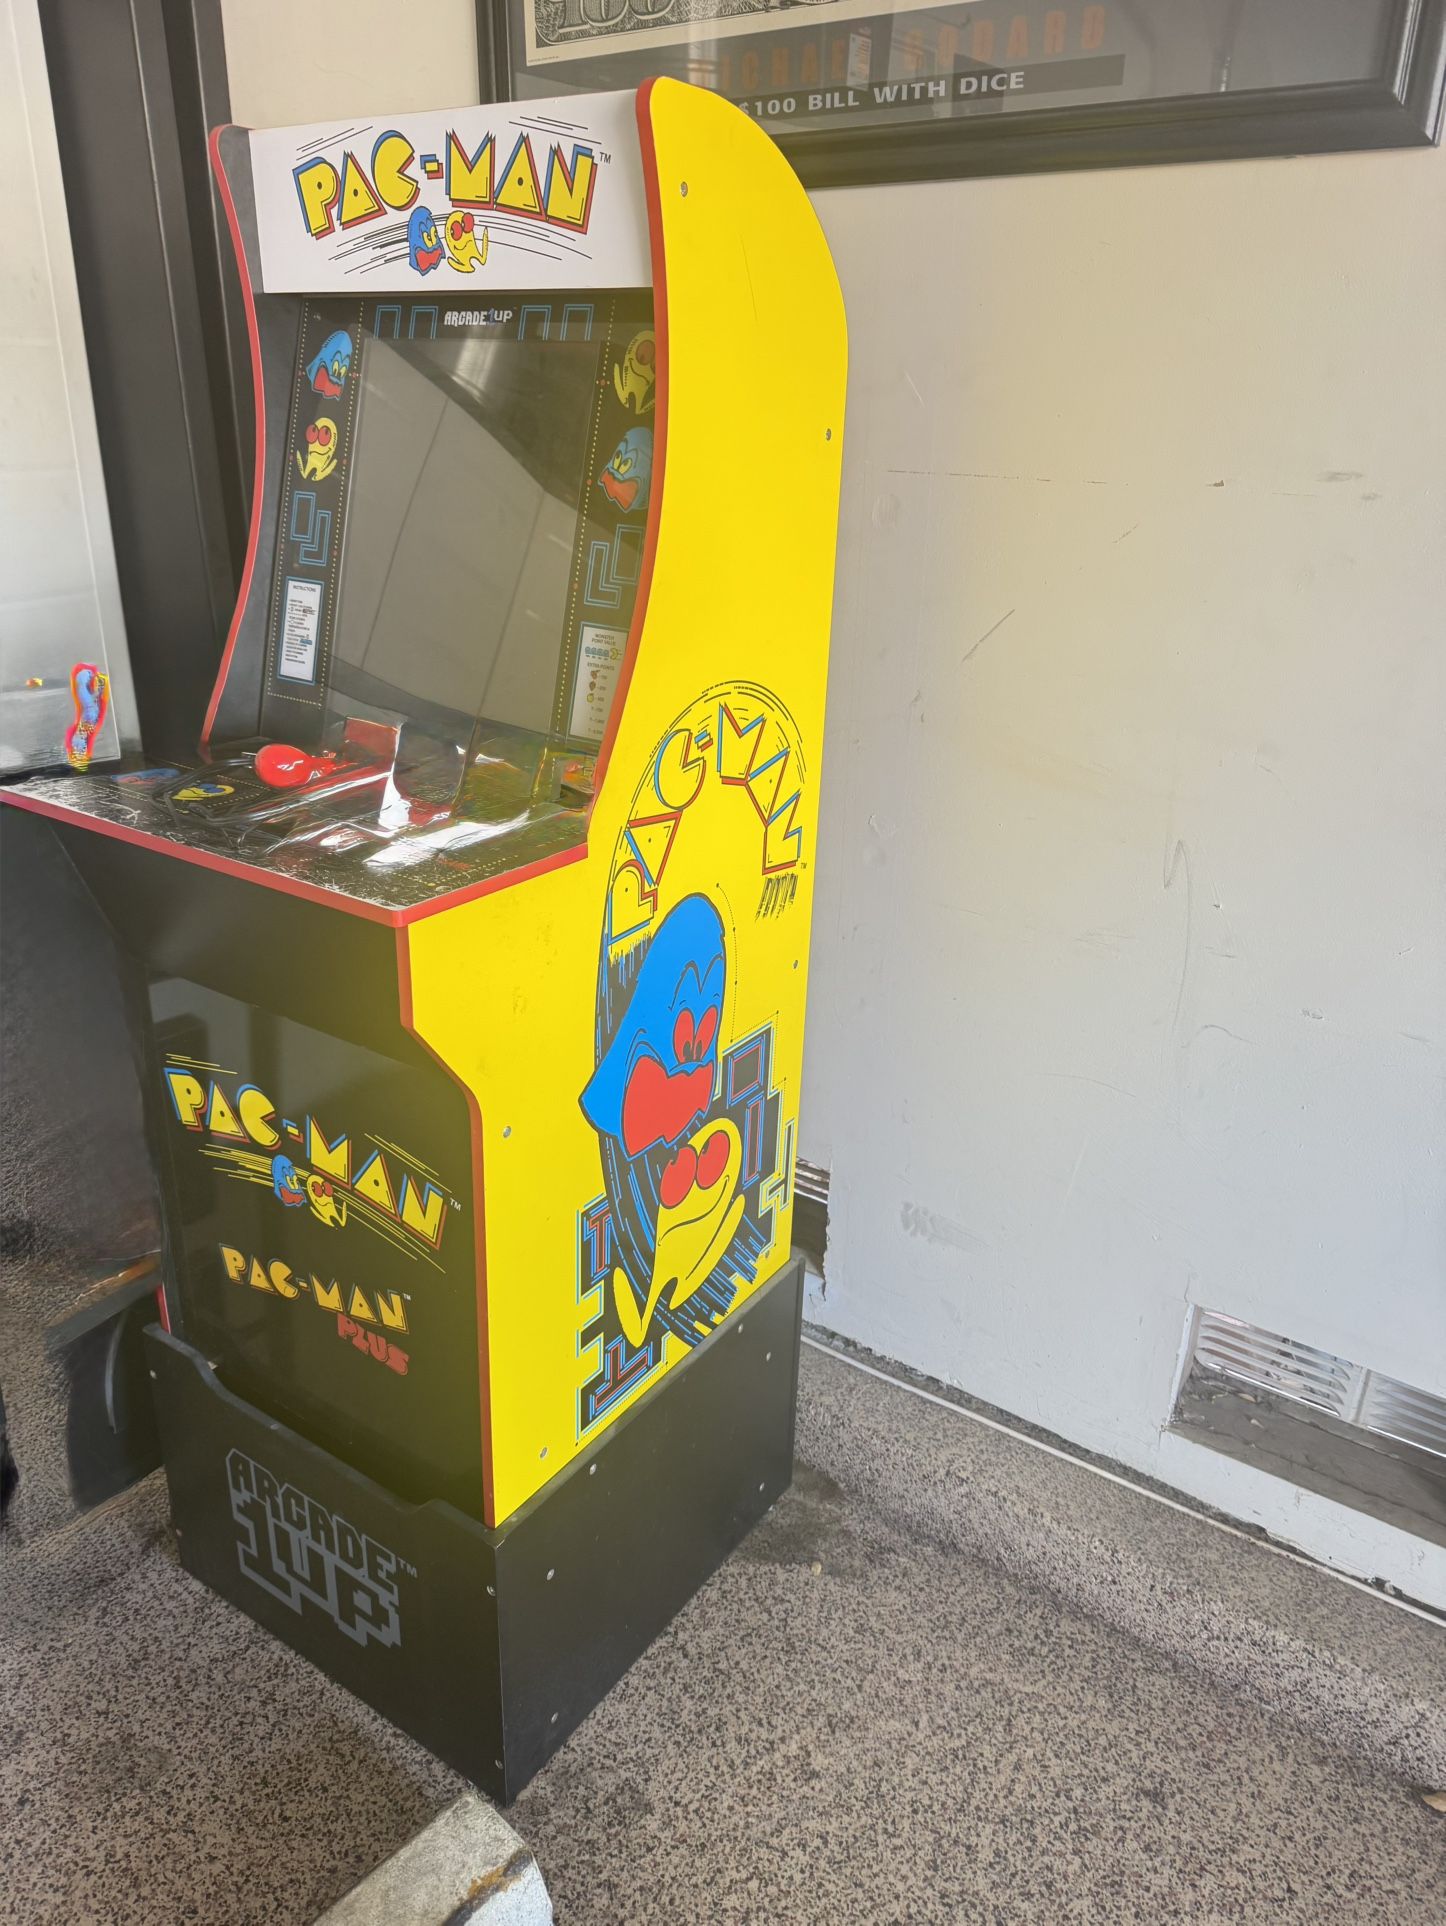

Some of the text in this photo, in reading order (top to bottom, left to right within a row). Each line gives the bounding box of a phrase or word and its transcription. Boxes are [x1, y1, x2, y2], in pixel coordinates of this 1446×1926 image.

[808, 90, 860, 111] BILL
[873, 79, 946, 104] WITH
[959, 71, 1025, 94] DICE
[292, 127, 599, 240] PAC-MAN
[163, 1067, 448, 1251] PAC-MAN
[218, 1242, 410, 1335] PAC-MAN
[336, 1311, 410, 1377] PLUS
[225, 1447, 400, 1608] ARCADE
